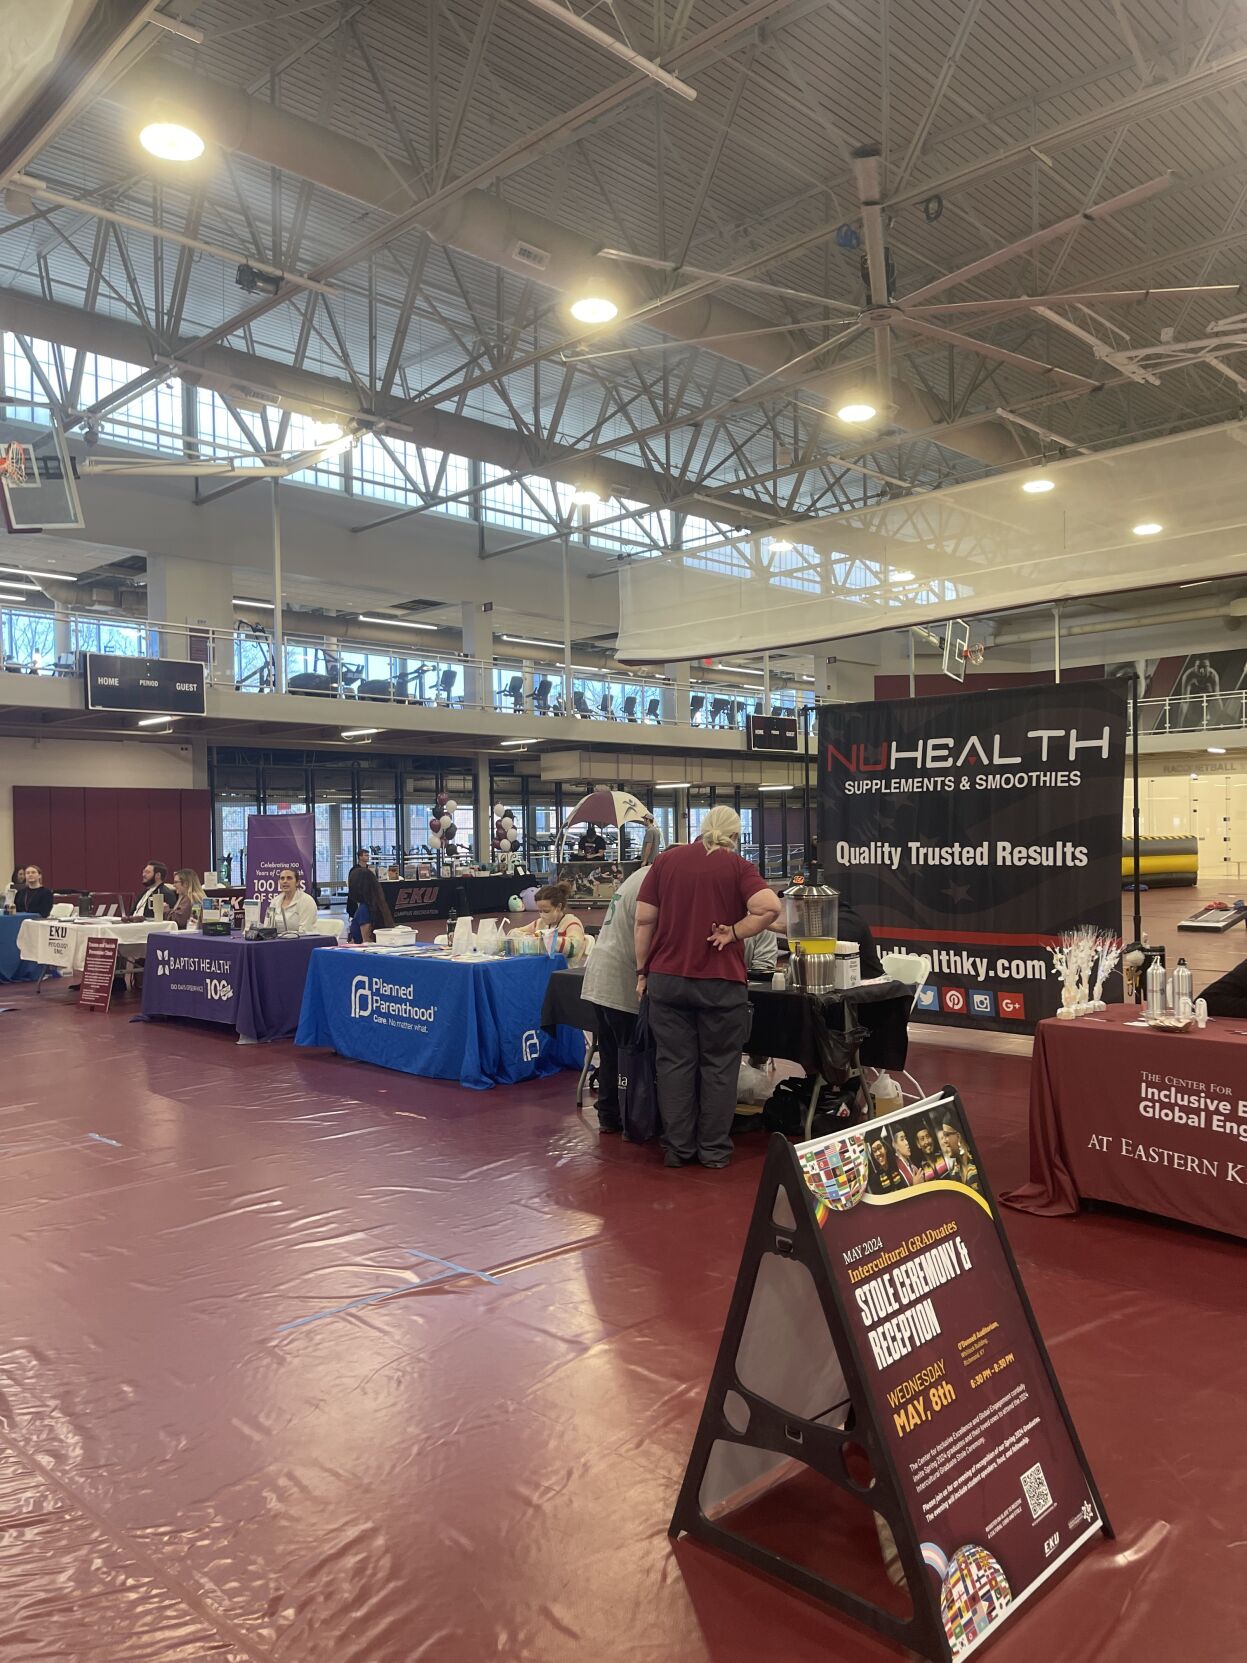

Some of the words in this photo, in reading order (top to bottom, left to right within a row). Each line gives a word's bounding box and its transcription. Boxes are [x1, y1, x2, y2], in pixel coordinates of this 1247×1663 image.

[98, 677, 119, 686] HOME
[176, 683, 197, 691] GUEST
[828, 726, 1109, 773] NUHEALTH
[844, 776, 955, 794] SUPPLEMENTS
[960, 776, 970, 790] &
[975, 771, 1081, 790] SMOOTHIES
[836, 841, 901, 869] Quality
[908, 841, 989, 866] Trusted
[996, 841, 1088, 866] Results
[253, 879, 275, 892] 100
[396, 887, 439, 905] EKU
[49, 926, 67, 938] EKU
[170, 957, 198, 971] BAPTIST
[200, 959, 230, 973] HEALTH
[373, 978, 413, 1000] Planned
[373, 996, 434, 1021] Parenthood
[373, 1015, 387, 1024] Care.
[388, 1018, 396, 1027] No
[396, 1021, 414, 1031] matter
[414, 1024, 428, 1033] what.
[1141, 1071, 1161, 1083] THE
[1165, 1075, 1205, 1091] CENTER
[1210, 1083, 1232, 1096] FOR
[1140, 1082, 1231, 1114] Inclusive
[1139, 1101, 1205, 1128] Global
[1088, 1134, 1112, 1151] AT
[1121, 1138, 1218, 1177] EASTERN
[842, 1244, 862, 1264] MAY
[862, 1235, 883, 1255] 2024
[848, 1241, 908, 1283] Intercultural
[908, 1221, 957, 1251] GRADuates
[855, 1273, 899, 1325] STOLE
[893, 1241, 959, 1303] CEREMONY
[955, 1236, 972, 1270] &
[868, 1299, 940, 1368] RECEPTION
[887, 1358, 945, 1407] WEDNESDAY
[970, 1373, 983, 1388] 6:30
[981, 1367, 992, 1380] PM
[1004, 1352, 1014, 1364] PM
[893, 1396, 930, 1436] MAY,
[929, 1380, 955, 1411] 8th
[1044, 1532, 1060, 1553] EKU
